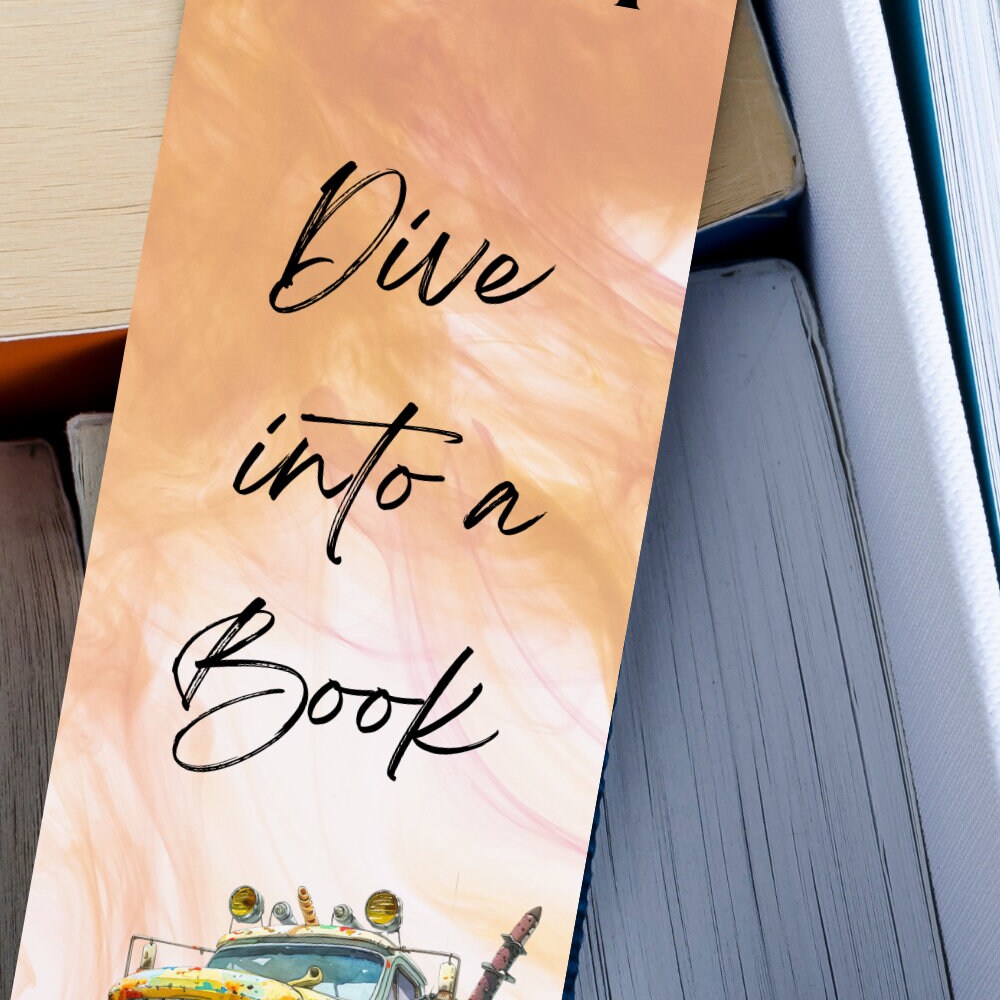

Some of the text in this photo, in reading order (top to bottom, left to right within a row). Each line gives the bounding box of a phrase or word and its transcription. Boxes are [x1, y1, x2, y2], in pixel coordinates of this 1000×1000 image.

[269, 160, 555, 314] Dive
[232, 402, 547, 565] into a
[172, 596, 499, 781] Book
